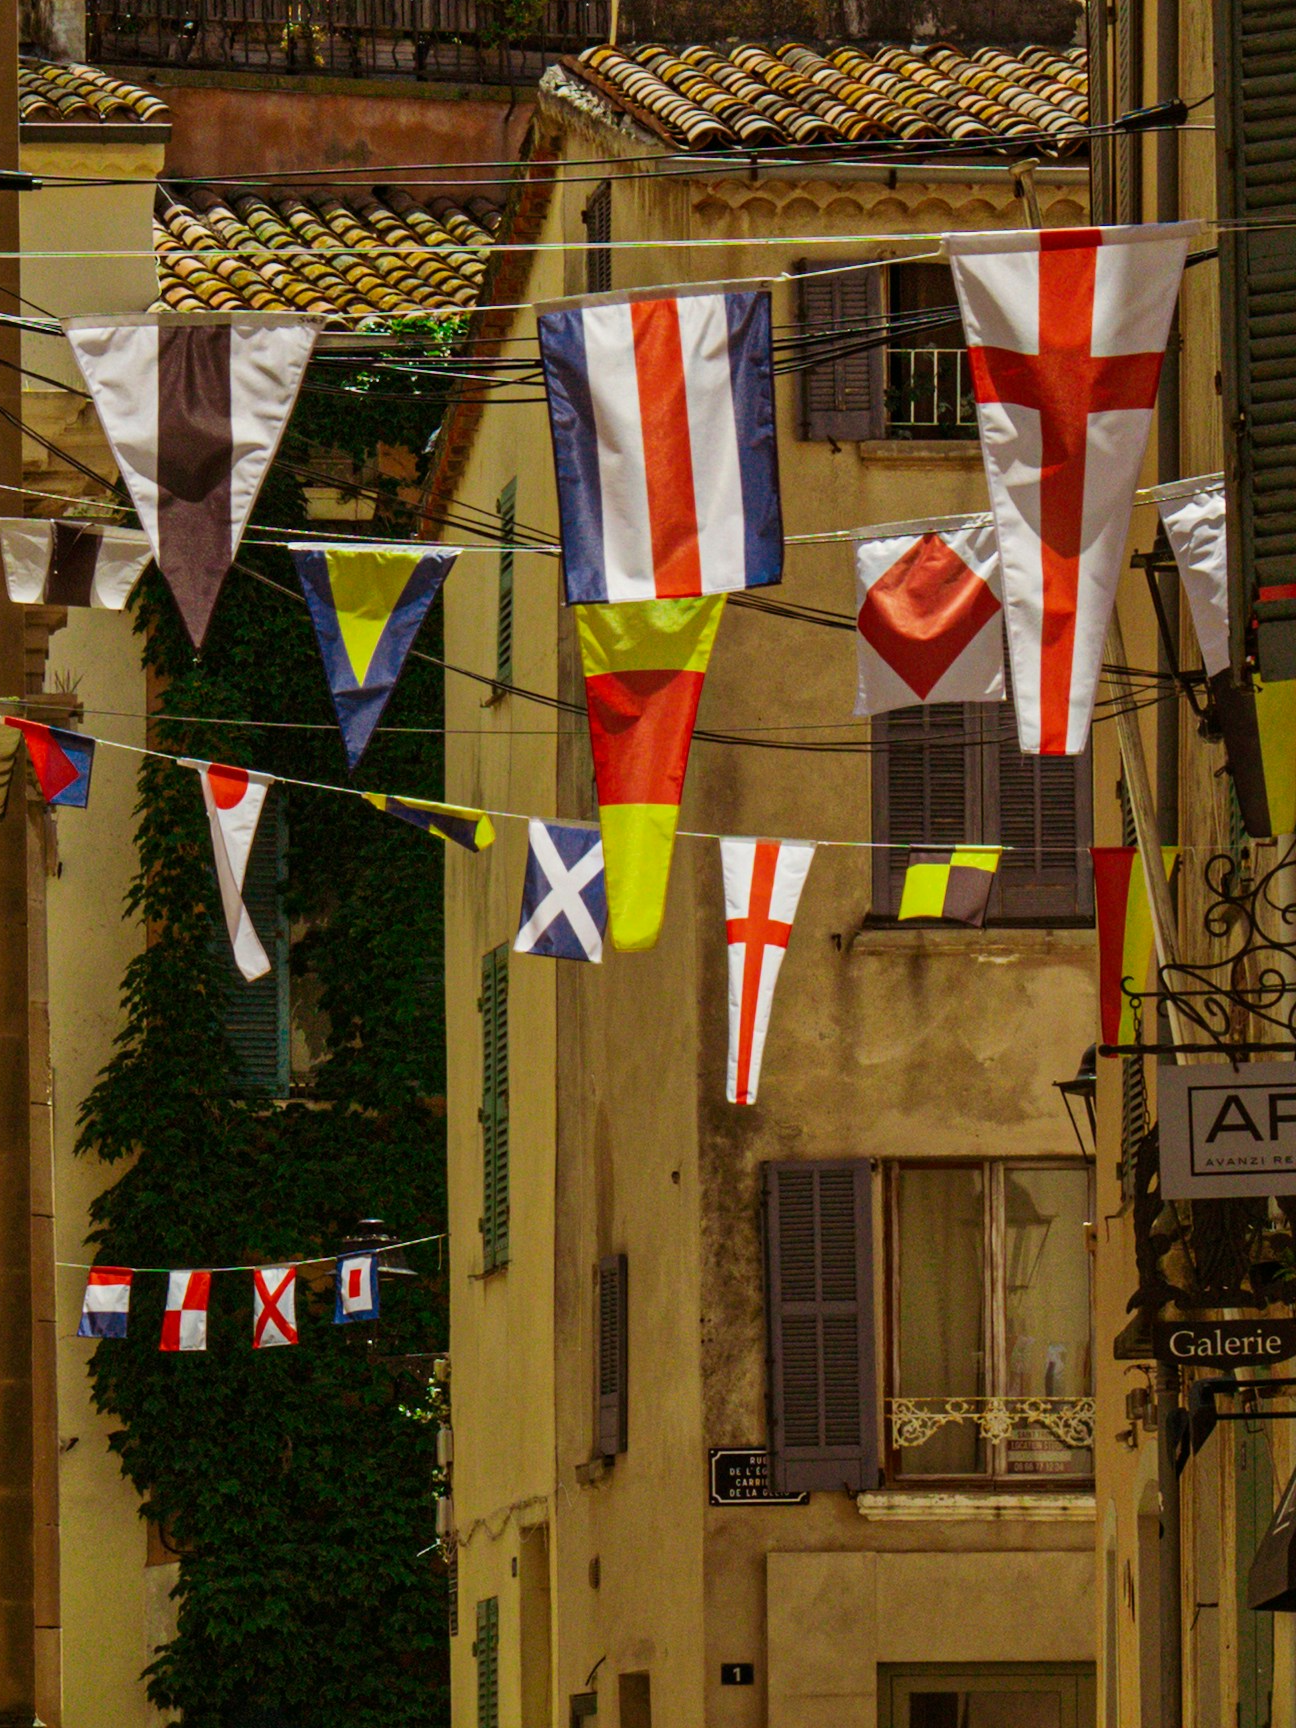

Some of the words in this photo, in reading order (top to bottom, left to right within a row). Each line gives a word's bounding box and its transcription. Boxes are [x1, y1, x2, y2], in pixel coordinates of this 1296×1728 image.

[1205, 1155, 1266, 1167] AVANZI
[1169, 1329, 1283, 1358] Galerie
[729, 1467, 742, 1476] DE
[729, 1488, 742, 1498] DE
[745, 1488, 758, 1497] LA
[732, 1666, 741, 1682] 1
